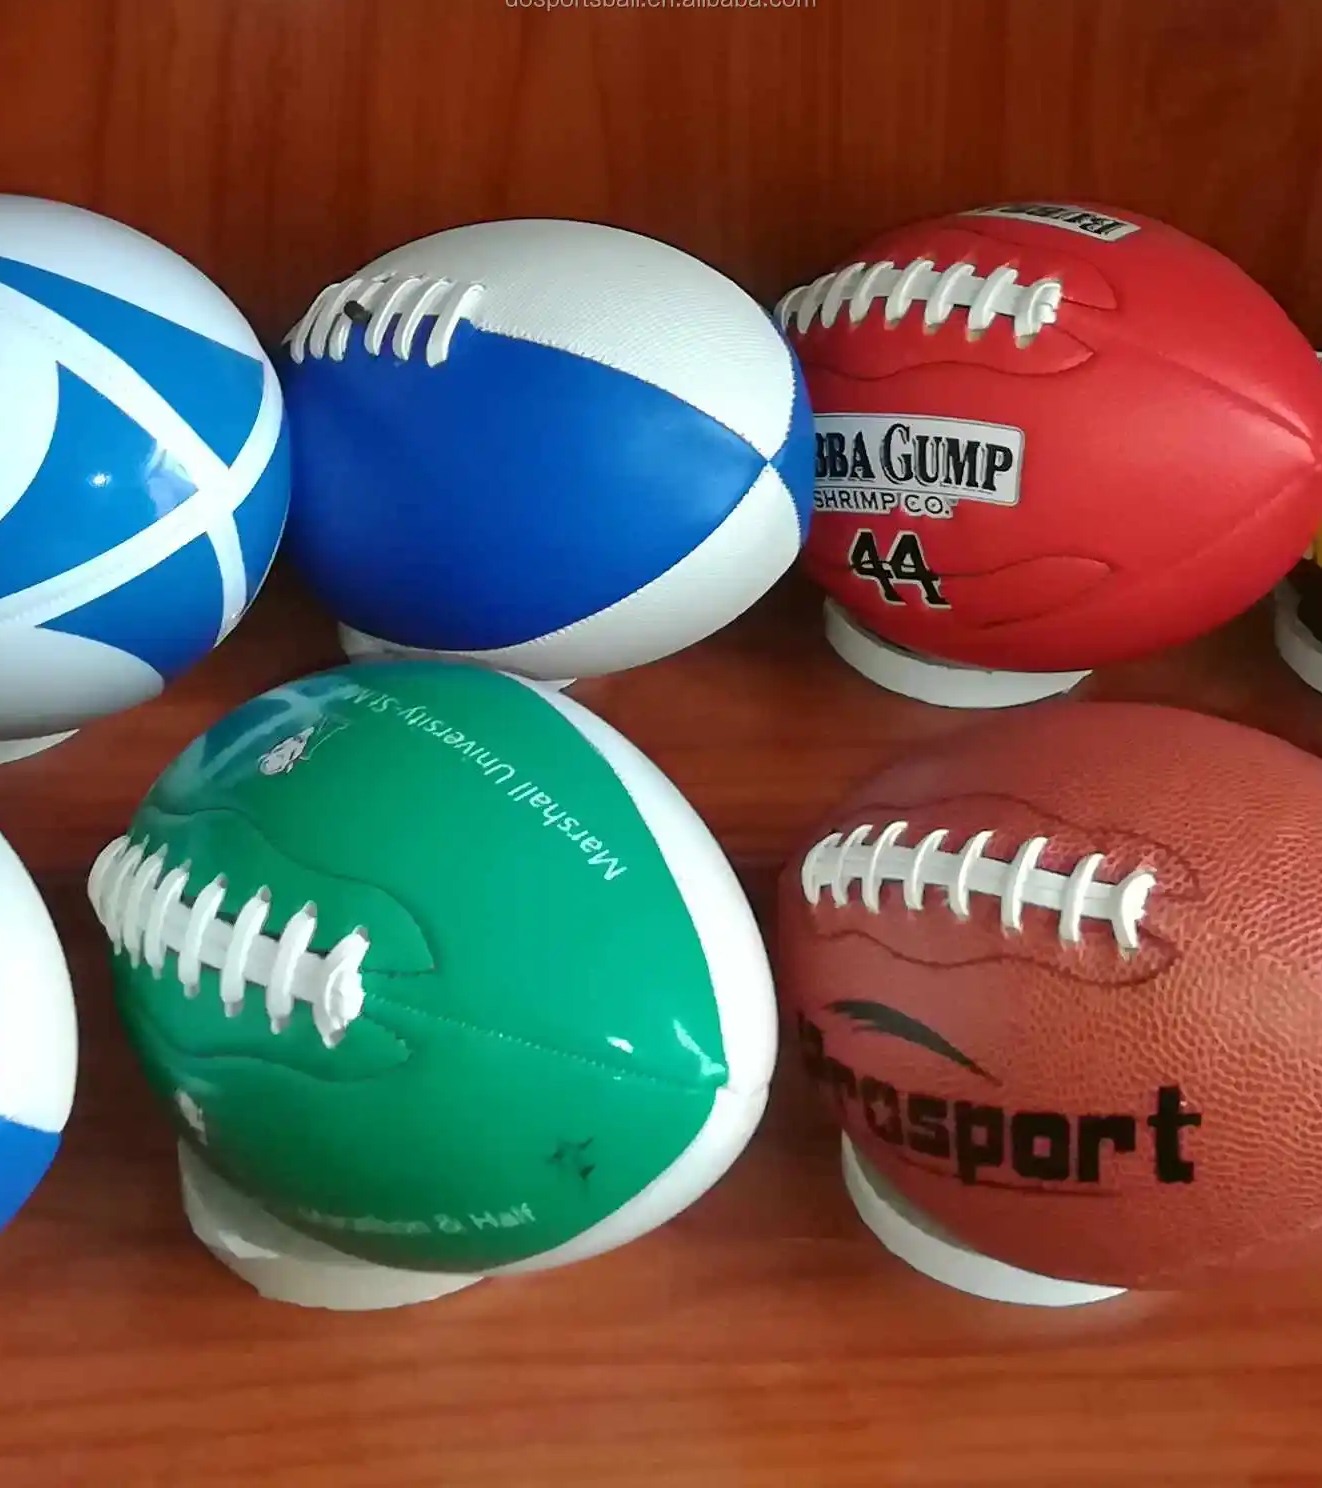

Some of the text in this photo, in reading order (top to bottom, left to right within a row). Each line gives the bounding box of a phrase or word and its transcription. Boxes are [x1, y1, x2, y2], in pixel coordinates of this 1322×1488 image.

[879, 423, 1013, 491] GUMP
[848, 528, 953, 609] 44
[508, 781, 627, 882] Marshall
